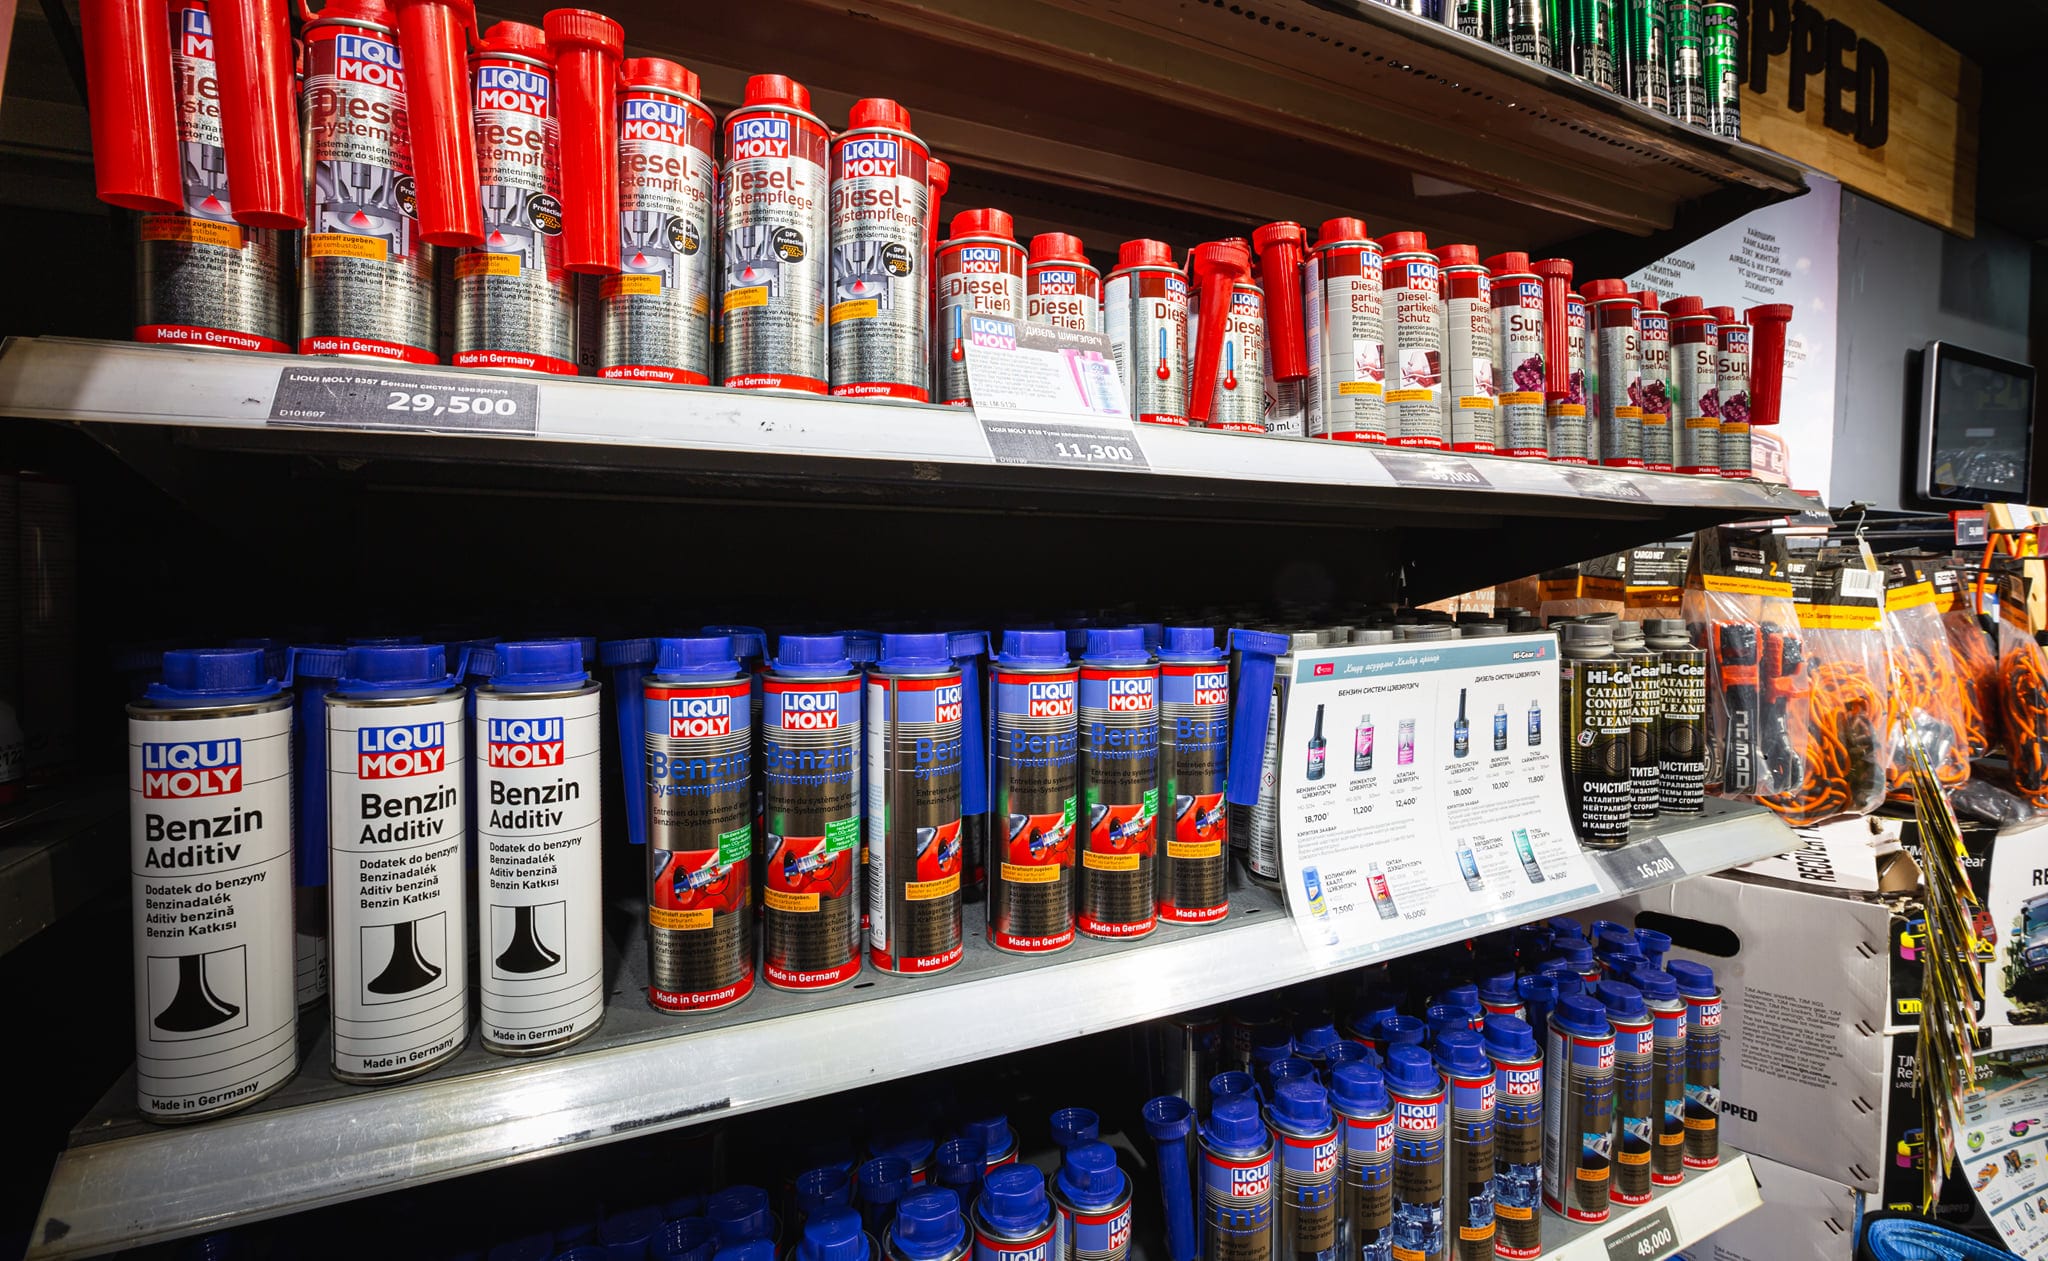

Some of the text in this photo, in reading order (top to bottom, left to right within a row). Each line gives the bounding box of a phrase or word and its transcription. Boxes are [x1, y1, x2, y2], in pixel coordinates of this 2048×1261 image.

[481, 68, 545, 95] LIQUI
[315, 87, 410, 131] Diese
[480, 91, 547, 117] MOLY
[625, 101, 684, 126] LIQUI
[624, 121, 684, 144] MOLY
[735, 120, 786, 145] LIQUI
[735, 140, 787, 161] MOLY
[845, 139, 896, 161] LIQUI
[844, 159, 896, 178] MOLY
[832, 184, 912, 211] Diesel-
[833, 208, 918, 227] Systempflege
[963, 249, 999, 262] LIQUI
[962, 260, 1000, 274] MOLY
[951, 277, 1009, 297] Diesel
[1040, 272, 1075, 284] LIQUI
[1040, 282, 1076, 296] MOLY
[1397, 292, 1432, 302] Diesel-
[974, 295, 1011, 312] Fließ
[1029, 299, 1084, 317] Diesel
[972, 318, 1013, 337] LIQUI
[1397, 313, 1431, 323] Schutz
[157, 328, 261, 350] Made in Germany
[973, 331, 1015, 351] MOLY
[289, 373, 321, 384] LIQUI
[321, 375, 353, 385] MOLY
[386, 391, 518, 417] 29,500
[1277, 421, 1290, 432] ml
[1055, 442, 1135, 462] 11,300
[1633, 550, 1665, 560] CARGO NET
[1512, 651, 1535, 660] Hi-Gear
[1495, 672, 1515, 681] СИСТЕМ
[1587, 670, 1632, 684] Hi-Ge
[1031, 681, 1073, 700] LIQUI
[1111, 678, 1151, 695] LIQUI
[1363, 686, 1387, 695] СИСТЕМ
[672, 697, 728, 719] LIQUI
[784, 692, 835, 711] LIQUI
[1031, 698, 1073, 717] MOLY
[1111, 693, 1152, 711] MOLY
[672, 716, 729, 737] MOLY
[784, 709, 836, 729] MOLY
[361, 723, 442, 752] LIQUI
[489, 718, 561, 743] LIQUI
[145, 740, 237, 770] LIQUI
[361, 748, 443, 778] MOLY
[489, 742, 563, 767] MOLY
[145, 767, 240, 797] MOLY
[1492, 781, 1509, 791] 10,100
[1527, 775, 1544, 784] 11,800
[489, 778, 580, 806] Benzin
[1452, 788, 1472, 797] 18,000
[360, 784, 457, 820] Benzin
[1353, 805, 1373, 815] 11,200
[1395, 797, 1416, 808] 12,400
[145, 806, 264, 842] Benzin
[489, 809, 563, 830] Additiv
[1304, 813, 1328, 823] 18,700
[1590, 821, 1615, 829] КАМЕР
[359, 818, 444, 845] Additiv
[489, 835, 582, 853] Dodatek do benzyny
[144, 842, 242, 869] Additiv
[359, 842, 459, 870] Dodatek do benzyny
[489, 853, 556, 866] Benzinadalék
[359, 863, 437, 883] Benzinadalék
[489, 865, 558, 878] Aditiv benzină
[1637, 856, 1675, 879] 16,200
[145, 871, 267, 896] Dodatek do benzyny
[359, 875, 439, 896] Aditiv benzină
[489, 877, 560, 890] Benzin Katkısı
[145, 892, 232, 910] Benzinadalék
[360, 889, 441, 909] Benzin Katkısı
[145, 905, 235, 924] Aditiv benzină
[146, 920, 237, 938] Benzin Katkısı
[1090, 920, 1152, 933] Made in Germany
[1008, 932, 1072, 949] Made in Germany
[768, 967, 840, 983] Made in Germany
[656, 986, 736, 1004] Made in Germany
[492, 1021, 575, 1042] Made in Germany
[362, 1036, 455, 1070] Made in Germany
[1508, 1069, 1540, 1084] LIQUI
[151, 1080, 260, 1111] Made in Germany
[1508, 1081, 1541, 1095] MOLY
[1400, 1103, 1437, 1118] LIQUI
[1721, 1100, 1758, 1123] PPED
[1400, 1116, 1438, 1131] MOLY
[1233, 1163, 1270, 1184] LIQUI
[1233, 1178, 1271, 1197] MOLY
[1637, 1227, 1672, 1256] 48,000
